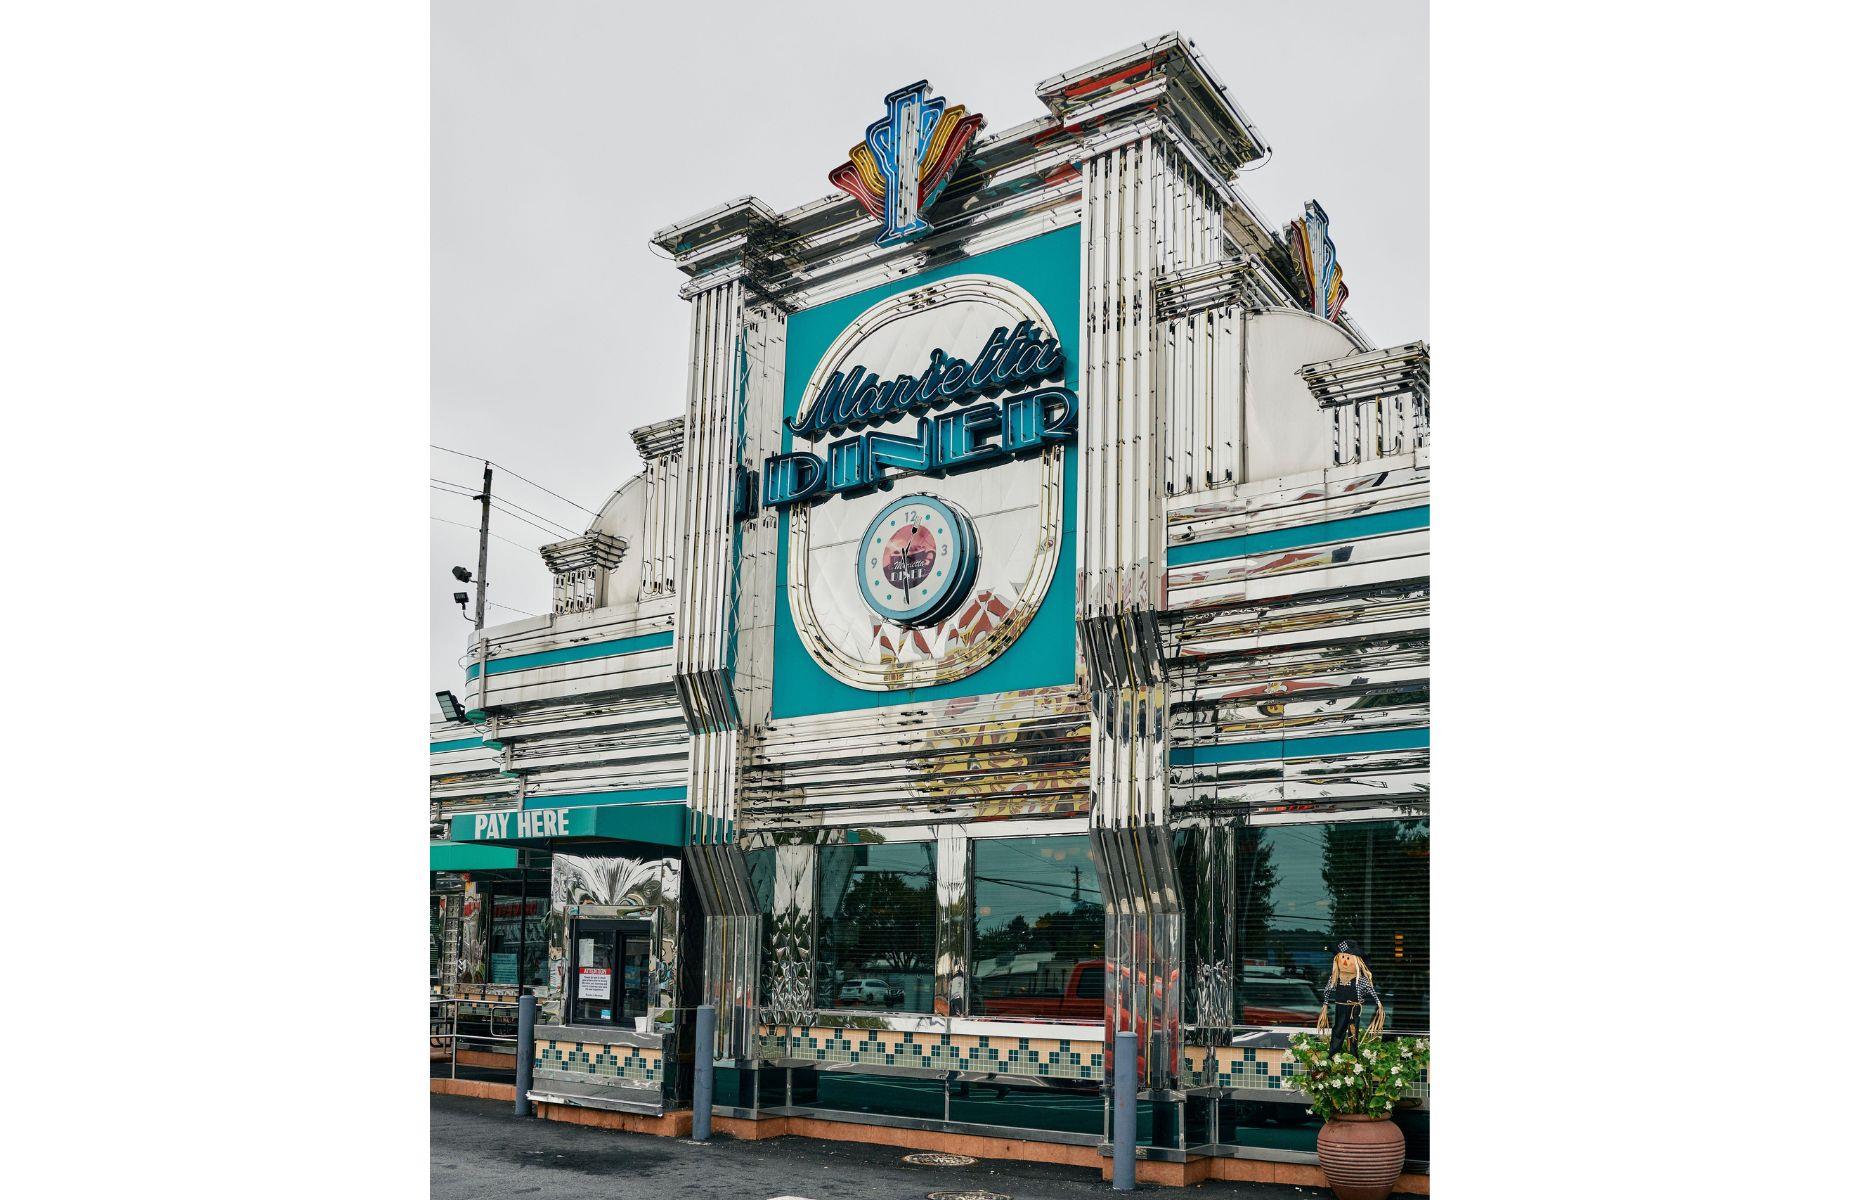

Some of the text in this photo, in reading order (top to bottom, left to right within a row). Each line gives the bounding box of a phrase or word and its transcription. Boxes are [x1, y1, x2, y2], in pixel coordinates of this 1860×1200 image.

[784, 320, 1064, 439] Marietta
[763, 387, 1078, 508] DINER
[905, 511, 917, 522] 12
[941, 545, 948, 556] 3
[871, 558, 878, 568] 9
[475, 808, 569, 839] PAY HERE
